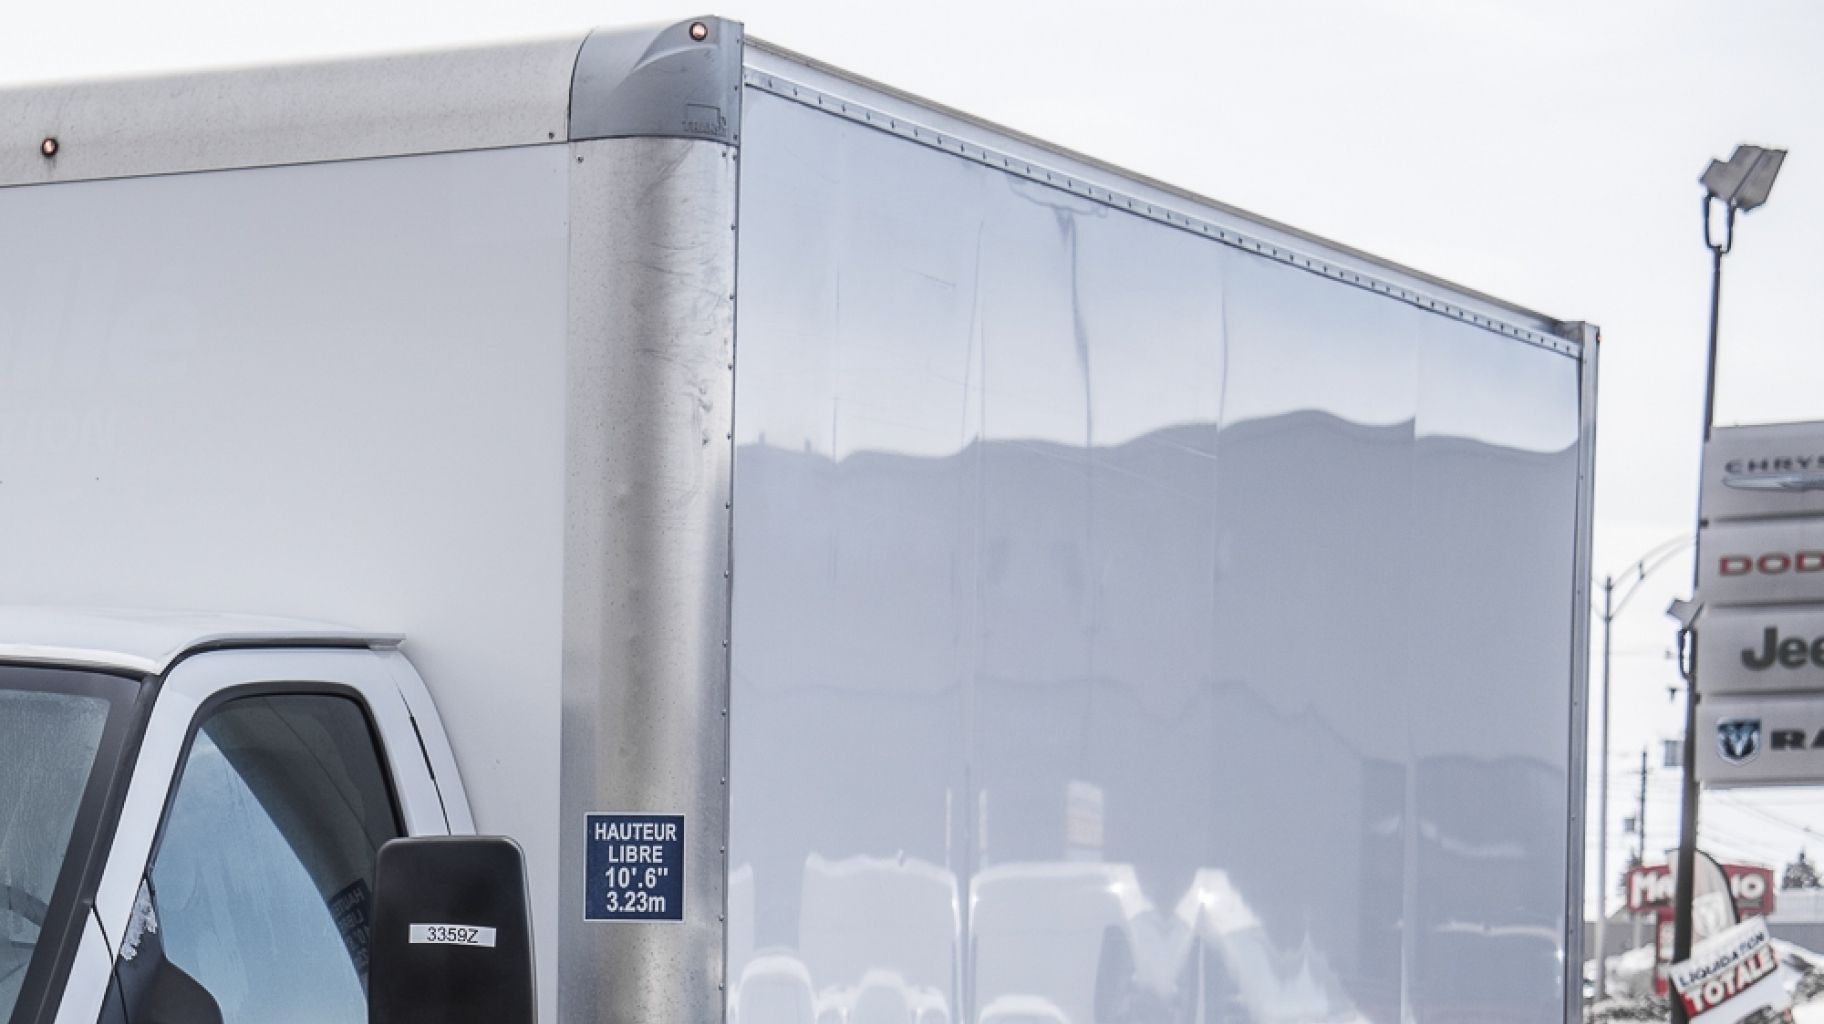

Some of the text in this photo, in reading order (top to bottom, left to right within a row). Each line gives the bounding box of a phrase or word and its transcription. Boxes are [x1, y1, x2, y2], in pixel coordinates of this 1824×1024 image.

[594, 822, 677, 841] HAUTEUR
[608, 845, 663, 864] LIBRE
[606, 892, 666, 913] 3.23m
[426, 926, 479, 944] 3359Z
[1684, 944, 1775, 1012] TOTALE
